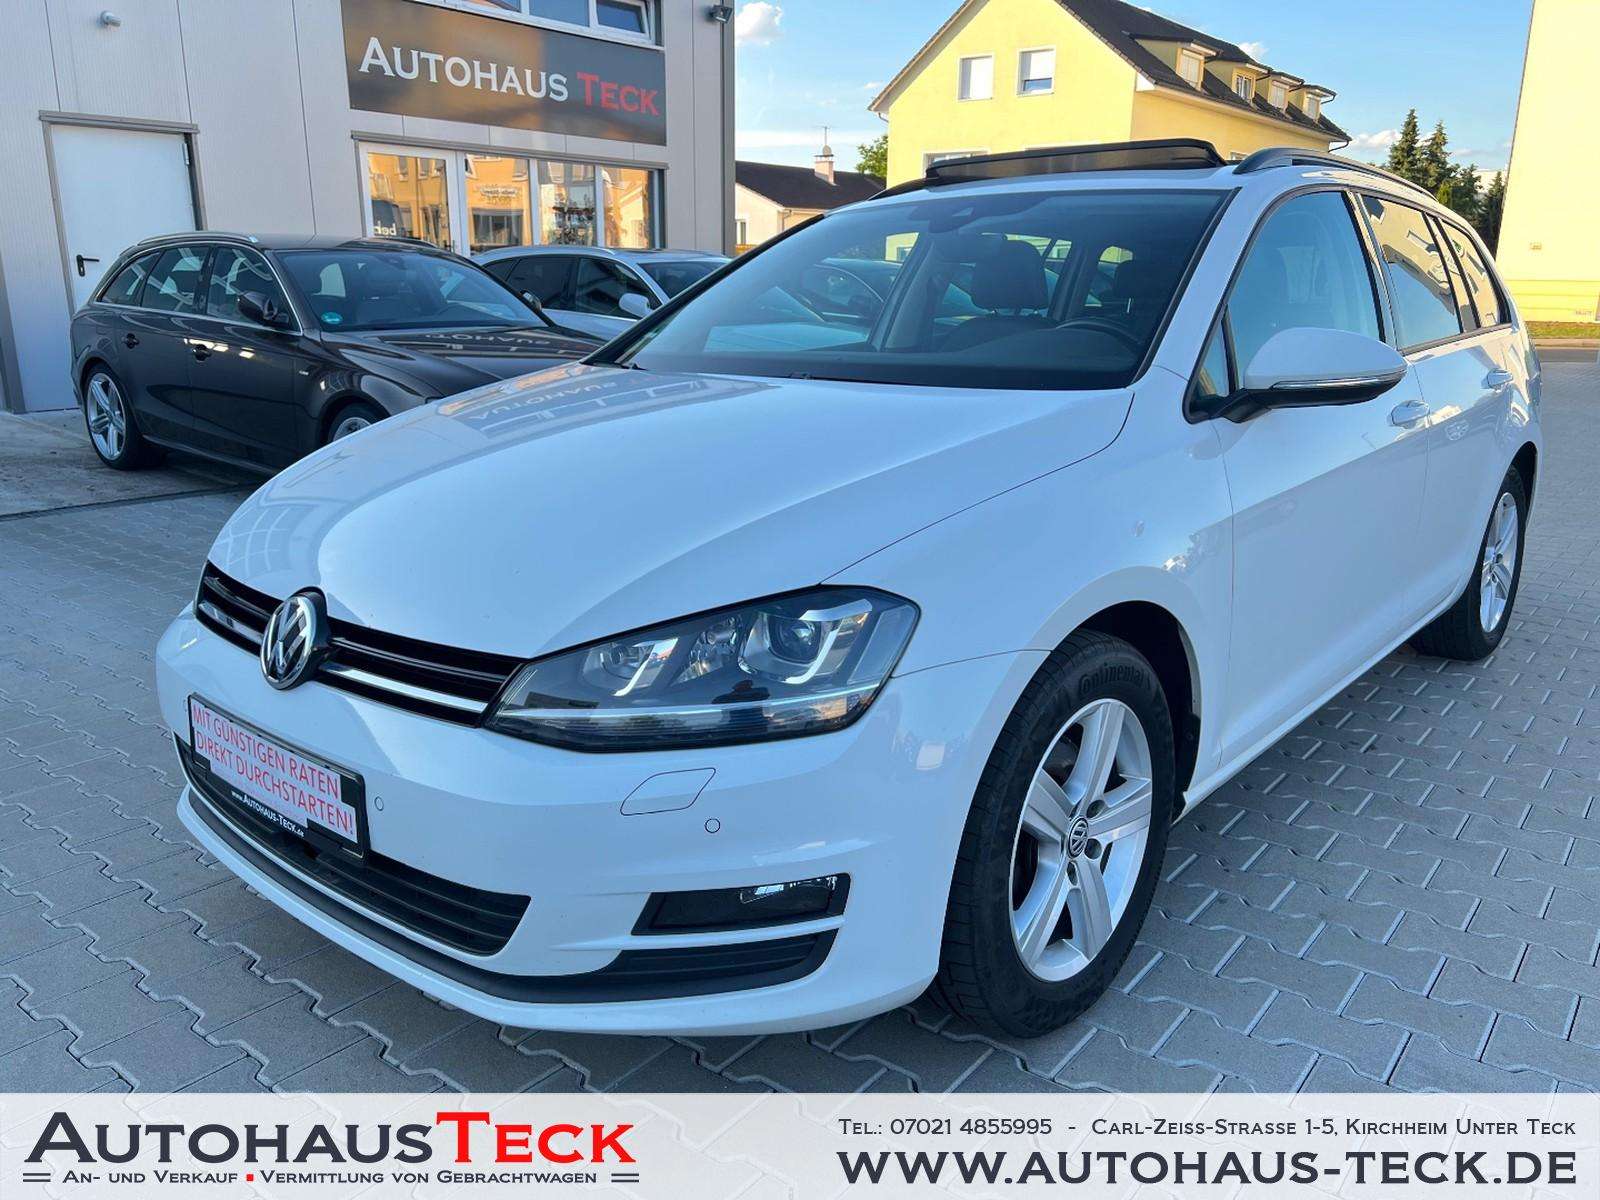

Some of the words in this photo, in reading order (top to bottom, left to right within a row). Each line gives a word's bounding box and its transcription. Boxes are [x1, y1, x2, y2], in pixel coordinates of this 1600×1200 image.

[358, 36, 570, 103] AUTOHAUS
[576, 71, 661, 117] TECK
[192, 703, 211, 728] MIT
[288, 756, 340, 800] RATEN
[196, 730, 233, 769] DIREKT
[235, 755, 354, 836] DURCHSTARTEN!
